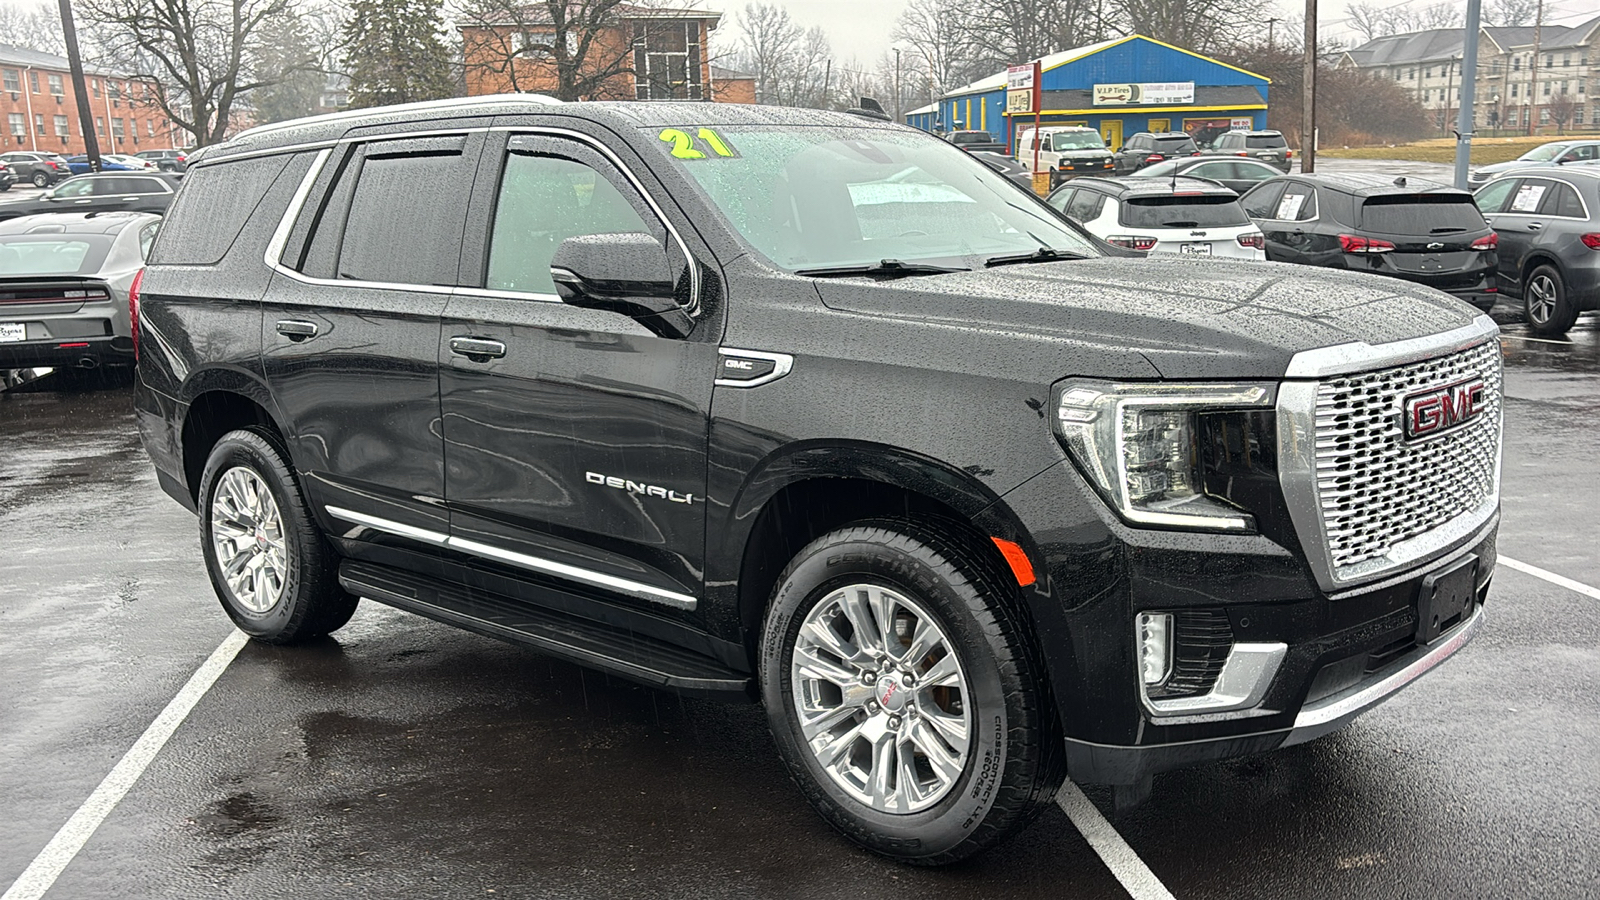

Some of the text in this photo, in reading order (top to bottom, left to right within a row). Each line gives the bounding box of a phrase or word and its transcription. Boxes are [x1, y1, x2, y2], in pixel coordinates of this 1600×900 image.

[1114, 86, 1130, 94] Tires
[658, 127, 734, 159] 21
[725, 359, 753, 370] GMC
[1412, 381, 1485, 434] GMC
[586, 471, 692, 505] DENALI
[882, 681, 898, 707] GMC
[962, 715, 1003, 829] CROSSCONTACT LX 20
